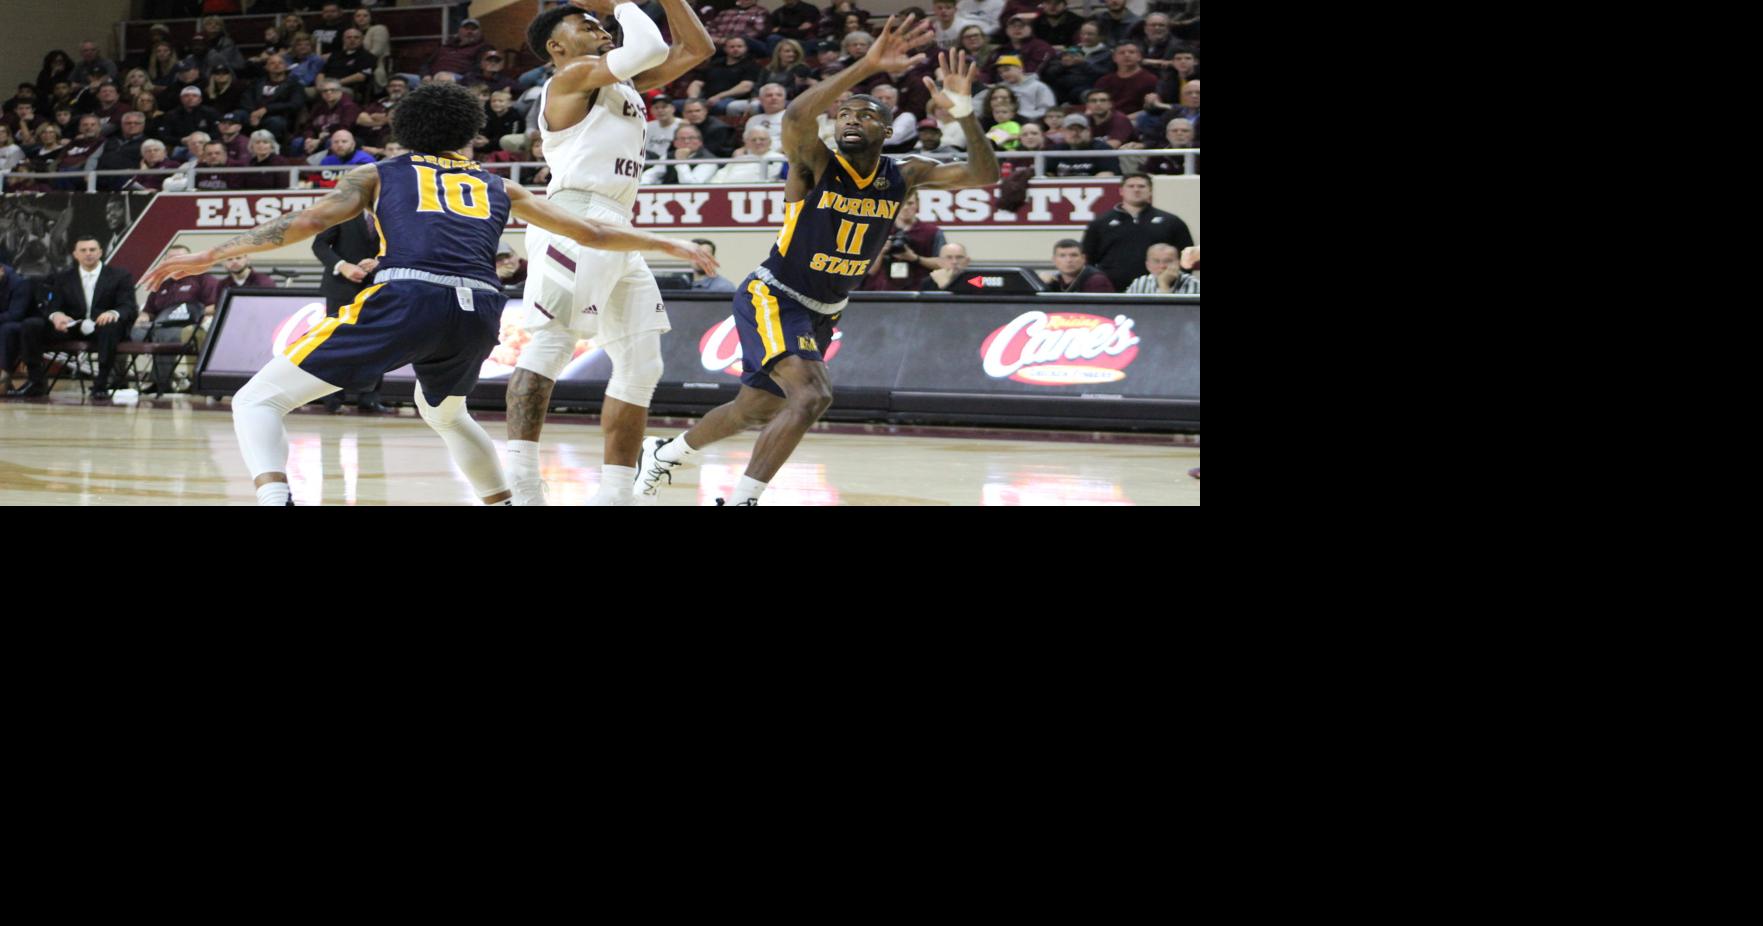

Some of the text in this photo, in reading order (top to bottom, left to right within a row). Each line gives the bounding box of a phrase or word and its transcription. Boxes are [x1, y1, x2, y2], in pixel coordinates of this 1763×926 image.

[411, 164, 491, 219] 10
[817, 190, 900, 219] MURRAY
[836, 218, 869, 255] 11
[809, 252, 871, 276] STATE
[983, 310, 1140, 378] Cane's
